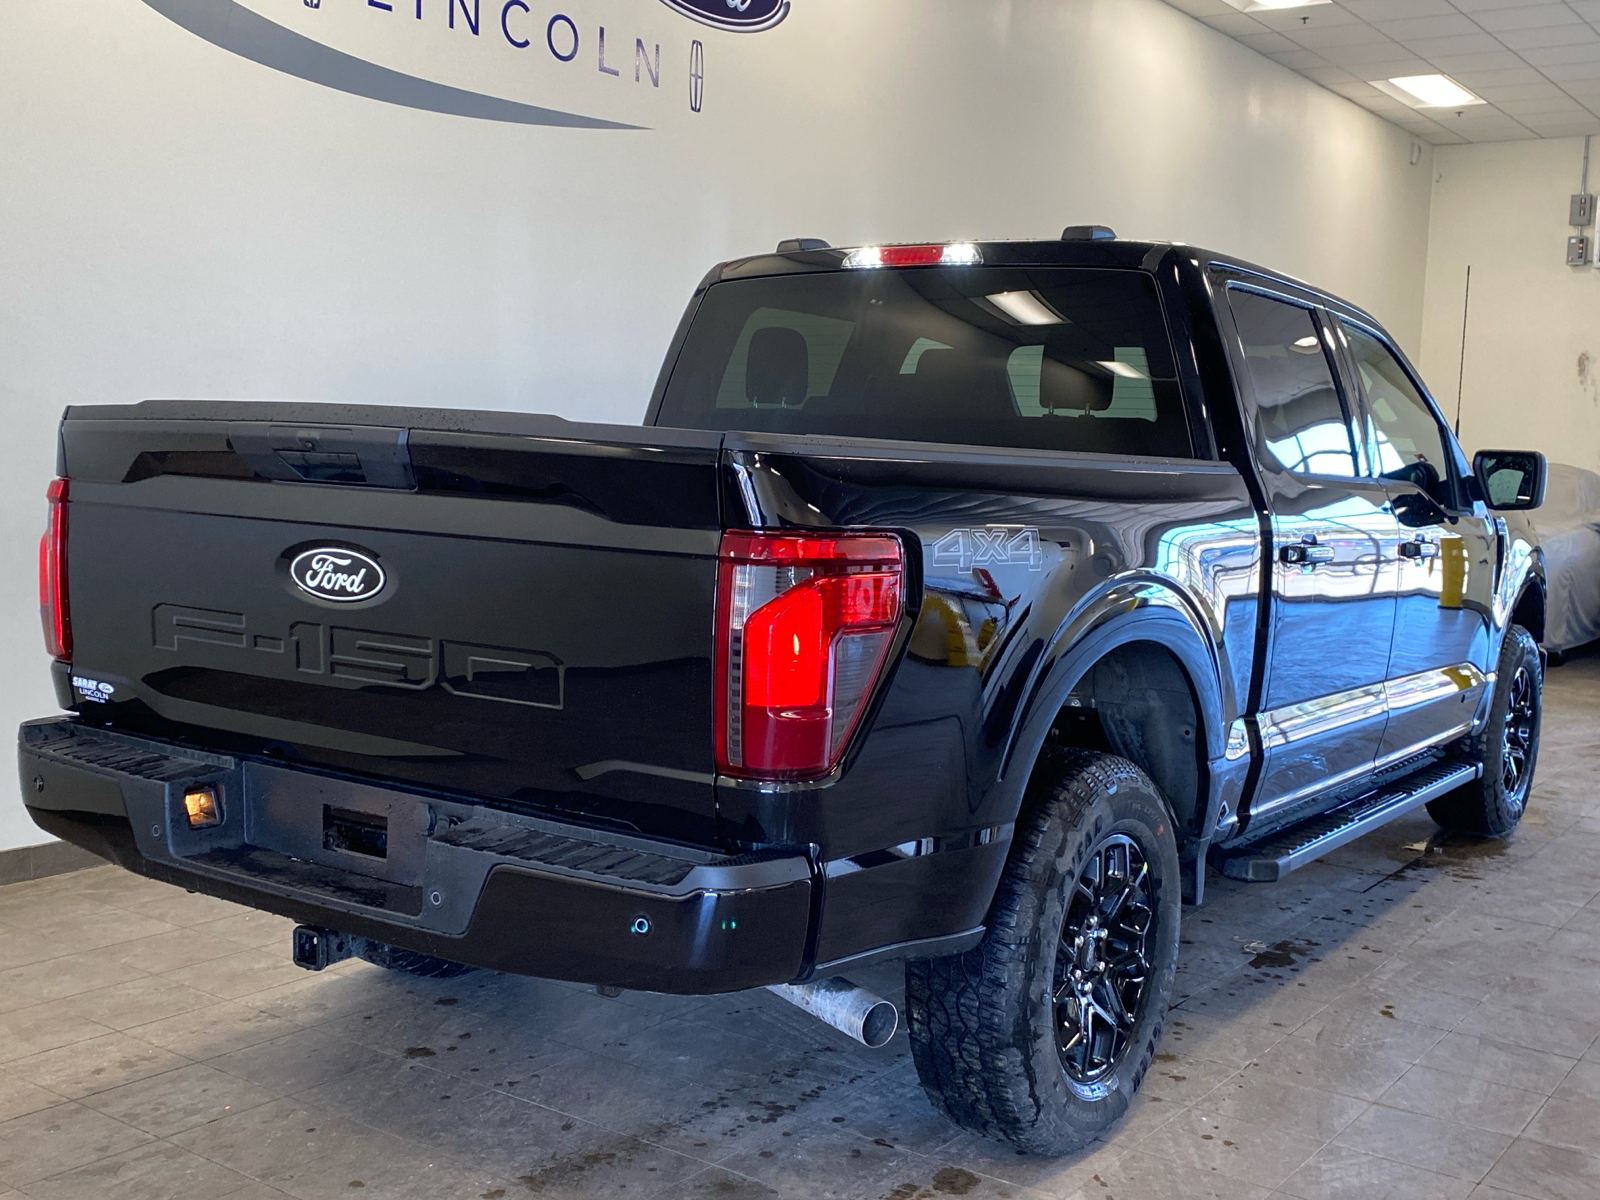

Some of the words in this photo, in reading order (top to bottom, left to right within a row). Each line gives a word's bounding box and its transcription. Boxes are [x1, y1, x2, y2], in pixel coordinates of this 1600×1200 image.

[368, 0, 659, 88] NCOLN
[306, 555, 366, 592] Ford
[152, 602, 564, 710] F-150
[79, 688, 109, 700] LINCOLN
